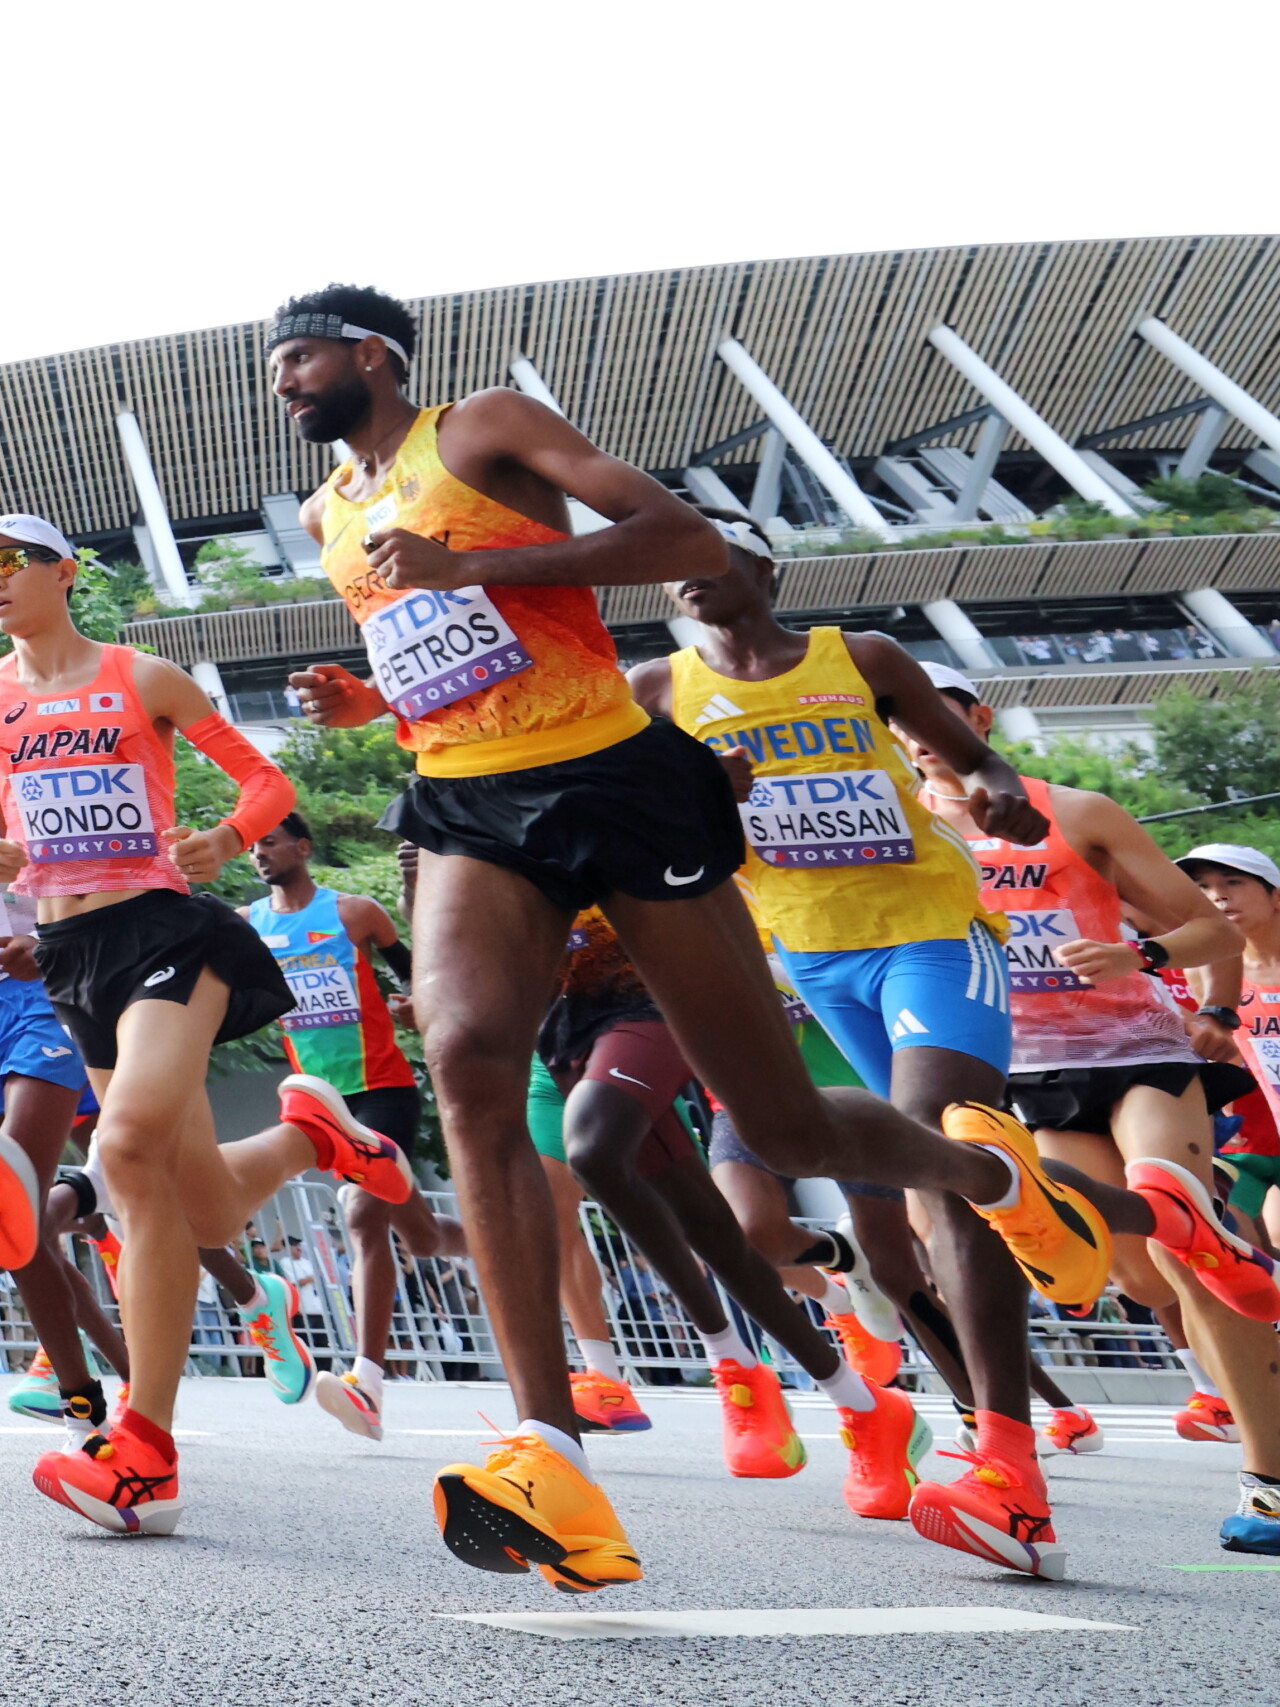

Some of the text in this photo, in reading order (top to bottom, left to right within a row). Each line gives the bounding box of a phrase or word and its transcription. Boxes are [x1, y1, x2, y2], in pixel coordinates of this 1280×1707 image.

[379, 589, 474, 639] TDK
[379, 612, 500, 695] PETROS
[411, 651, 522, 707] TOKYO 25
[798, 694, 864, 705] BAUHAUS
[10, 727, 122, 763] JAPAN
[704, 718, 876, 763] SWEDEN
[40, 768, 135, 798] TDK
[771, 775, 885, 806] TDK
[26, 802, 142, 837] KONDO
[50, 839, 152, 856] TOKYO 25
[788, 845, 909, 863] TOKYO 25
[286, 970, 343, 991] TDK
[1064, 976, 1075, 987] 2
[291, 990, 352, 1014] MARE
